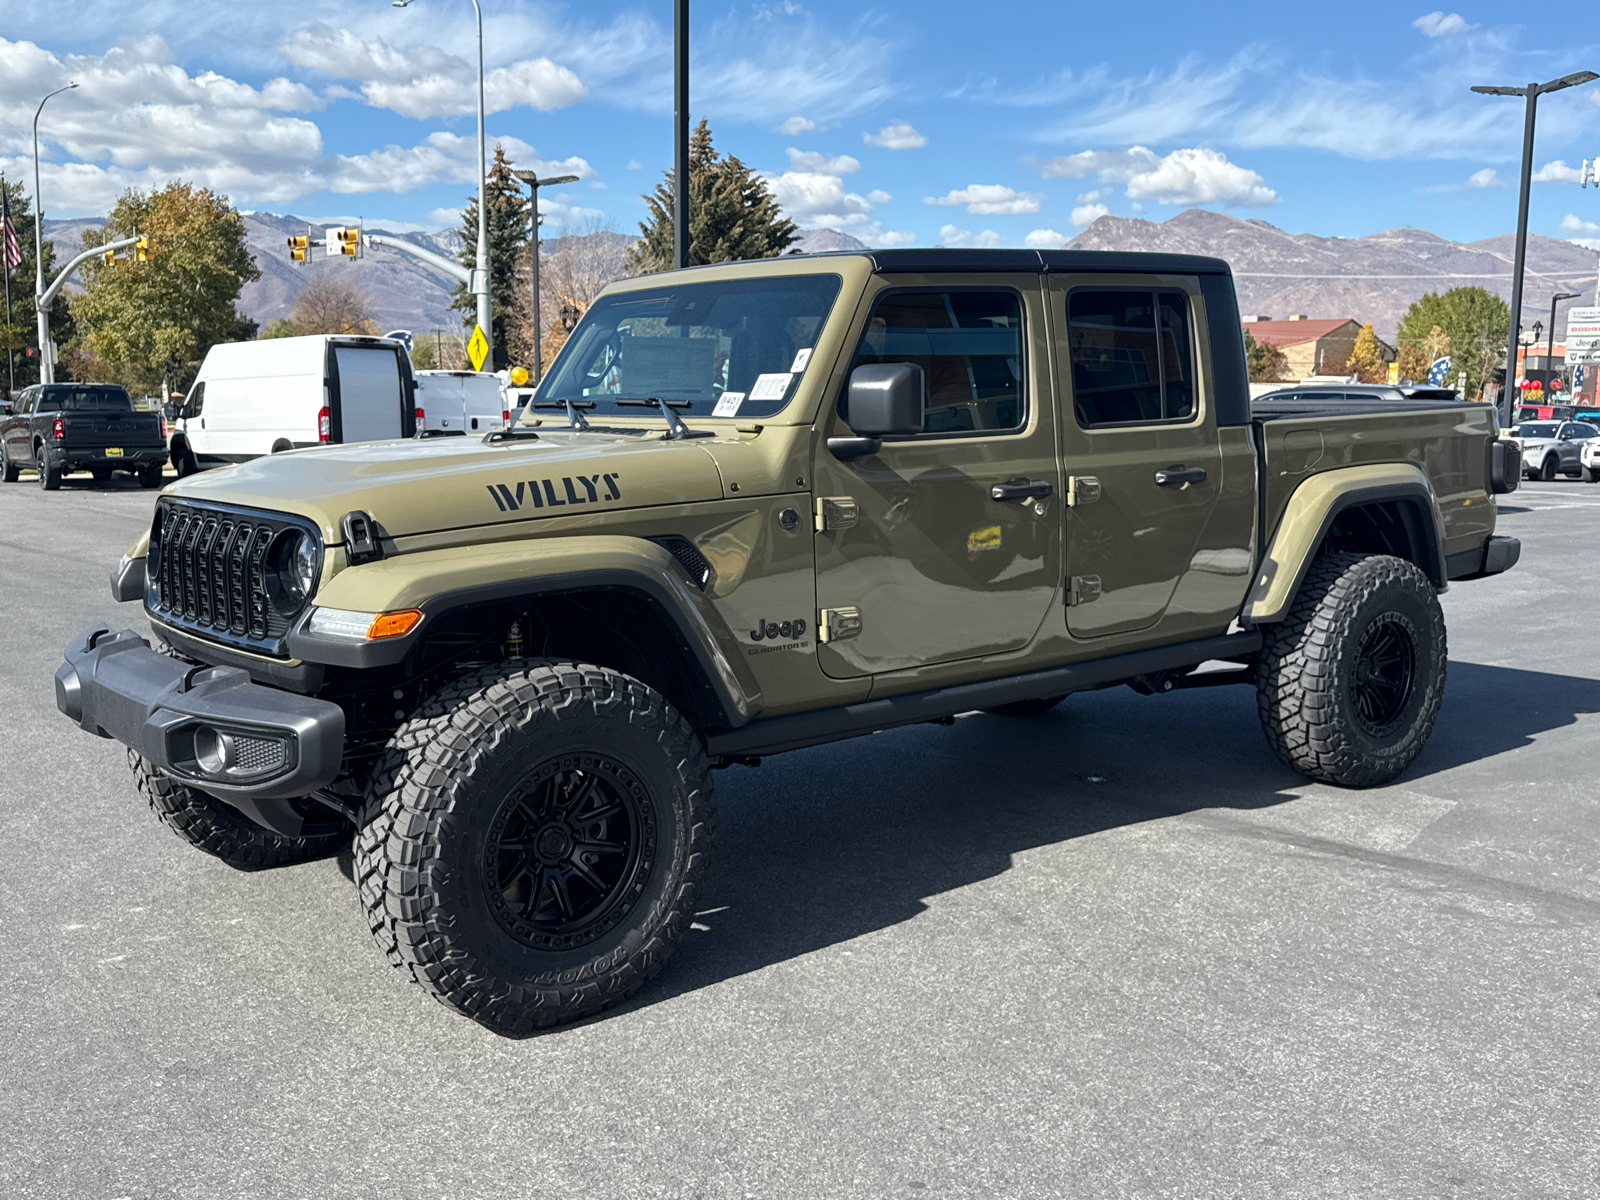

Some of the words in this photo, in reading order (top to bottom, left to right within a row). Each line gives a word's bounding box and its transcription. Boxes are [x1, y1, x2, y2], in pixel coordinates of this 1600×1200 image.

[1575, 339, 1598, 348] Jeep
[486, 473, 621, 511] WILLYS
[750, 618, 807, 641] Jeep
[748, 642, 800, 655] GLADIATOR
[557, 945, 627, 984] TOYO
